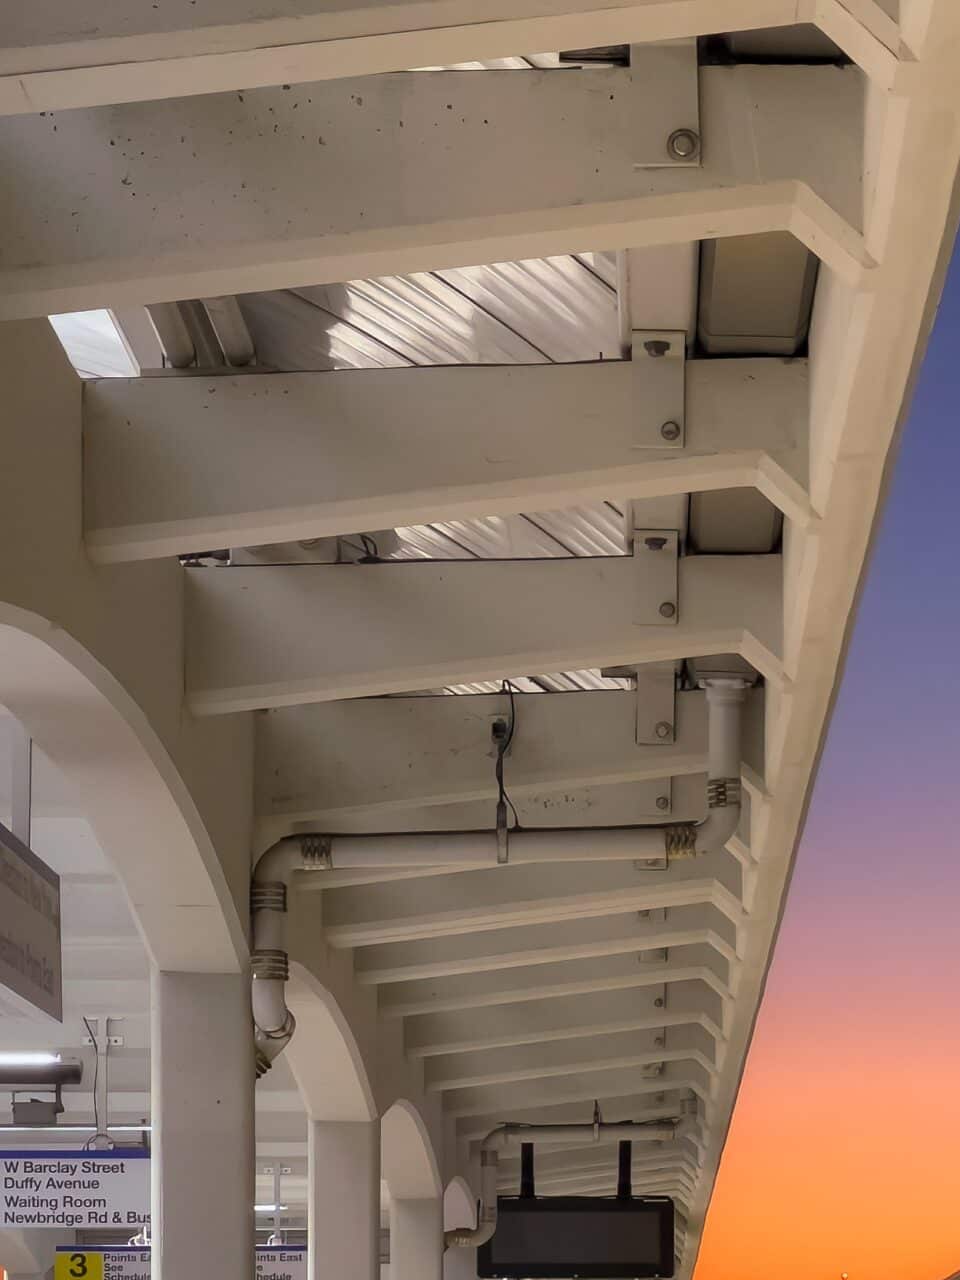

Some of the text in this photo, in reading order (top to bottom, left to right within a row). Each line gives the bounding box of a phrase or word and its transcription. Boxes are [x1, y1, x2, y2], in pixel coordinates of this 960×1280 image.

[4, 1161, 125, 1176] W Barclay Street
[4, 1177, 99, 1191] Duffy Avenue
[4, 1196, 106, 1210] Waiting Room
[4, 1211, 83, 1226] Newbridge
[88, 1211, 108, 1223] Rd
[112, 1212, 122, 1223] &
[103, 1253, 137, 1262] Points
[280, 1253, 302, 1262] East
[69, 1253, 88, 1278] 3
[104, 1263, 123, 1272] See
